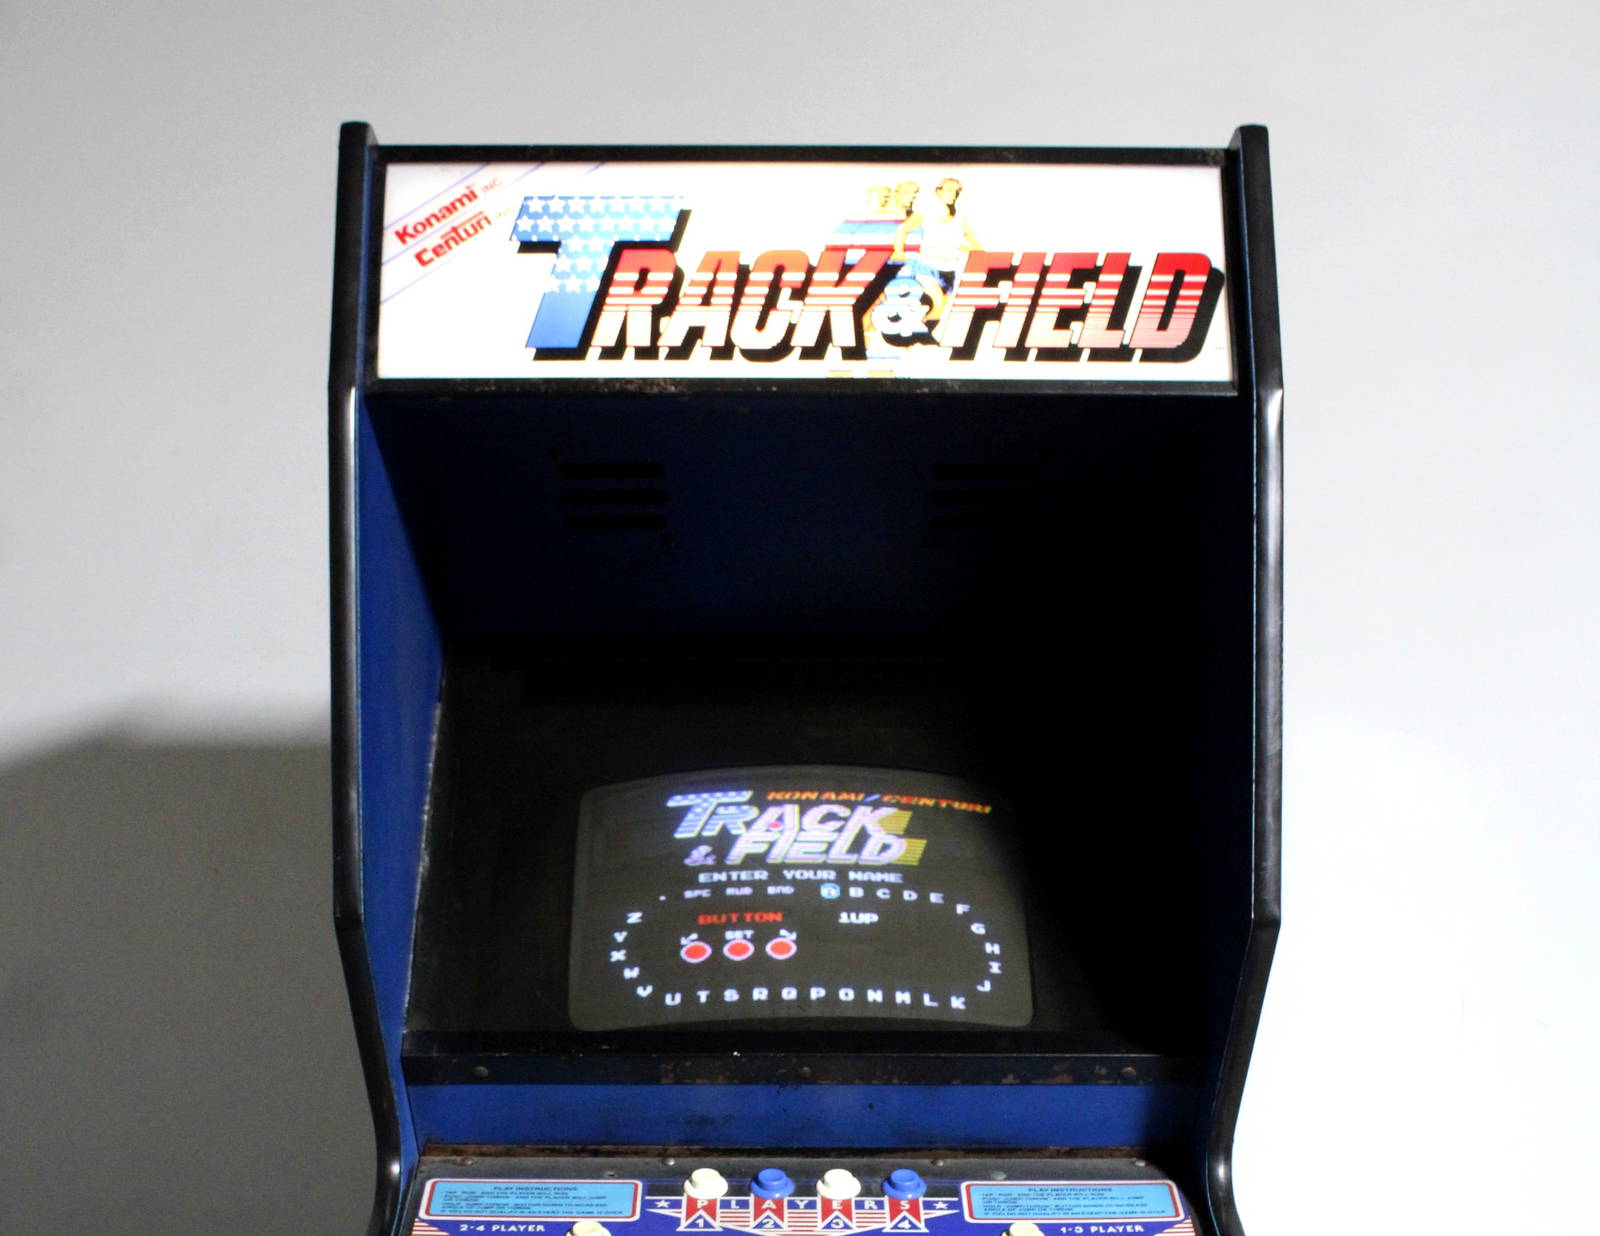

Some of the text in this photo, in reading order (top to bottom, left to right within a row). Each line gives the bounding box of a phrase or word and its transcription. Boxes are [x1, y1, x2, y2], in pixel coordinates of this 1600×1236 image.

[394, 183, 479, 245] Konami
[414, 210, 492, 267] Centuri
[510, 196, 893, 360] TRACK
[939, 250, 1223, 361] FIELD
[666, 789, 900, 838] TRACK
[725, 830, 908, 866] FIELD
[698, 869, 905, 884] ENTER YOUR NAME
[766, 884, 796, 895] END
[848, 885, 865, 898] B
[876, 887, 892, 900] C
[903, 889, 919, 901] D
[929, 891, 945, 904] E
[956, 903, 971, 915] F
[626, 911, 643, 924] Z
[697, 911, 880, 925] BUTTON 1UP
[724, 929, 755, 940] SET
[970, 922, 987, 935] G
[613, 930, 628, 943] Y
[610, 949, 627, 962] X
[985, 942, 1001, 956] H
[623, 966, 641, 979] W
[636, 984, 653, 998] V
[975, 979, 992, 993] J
[665, 991, 682, 1007] U
[696, 989, 711, 1004] T
[723, 988, 740, 1002] S
[752, 985, 769, 1002] R
[810, 986, 827, 1001] P
[838, 986, 856, 1002] O
[867, 988, 884, 1004] N
[923, 992, 939, 1007] L
[950, 994, 967, 1010] K
[460, 1223, 546, 1232] 2-4 PLAYER
[696, 1218, 705, 1229] 1
[762, 1218, 775, 1229] 2
[830, 1218, 845, 1230] 3
[896, 1219, 912, 1230] 4
[1090, 1224, 1145, 1233] PLAYER
